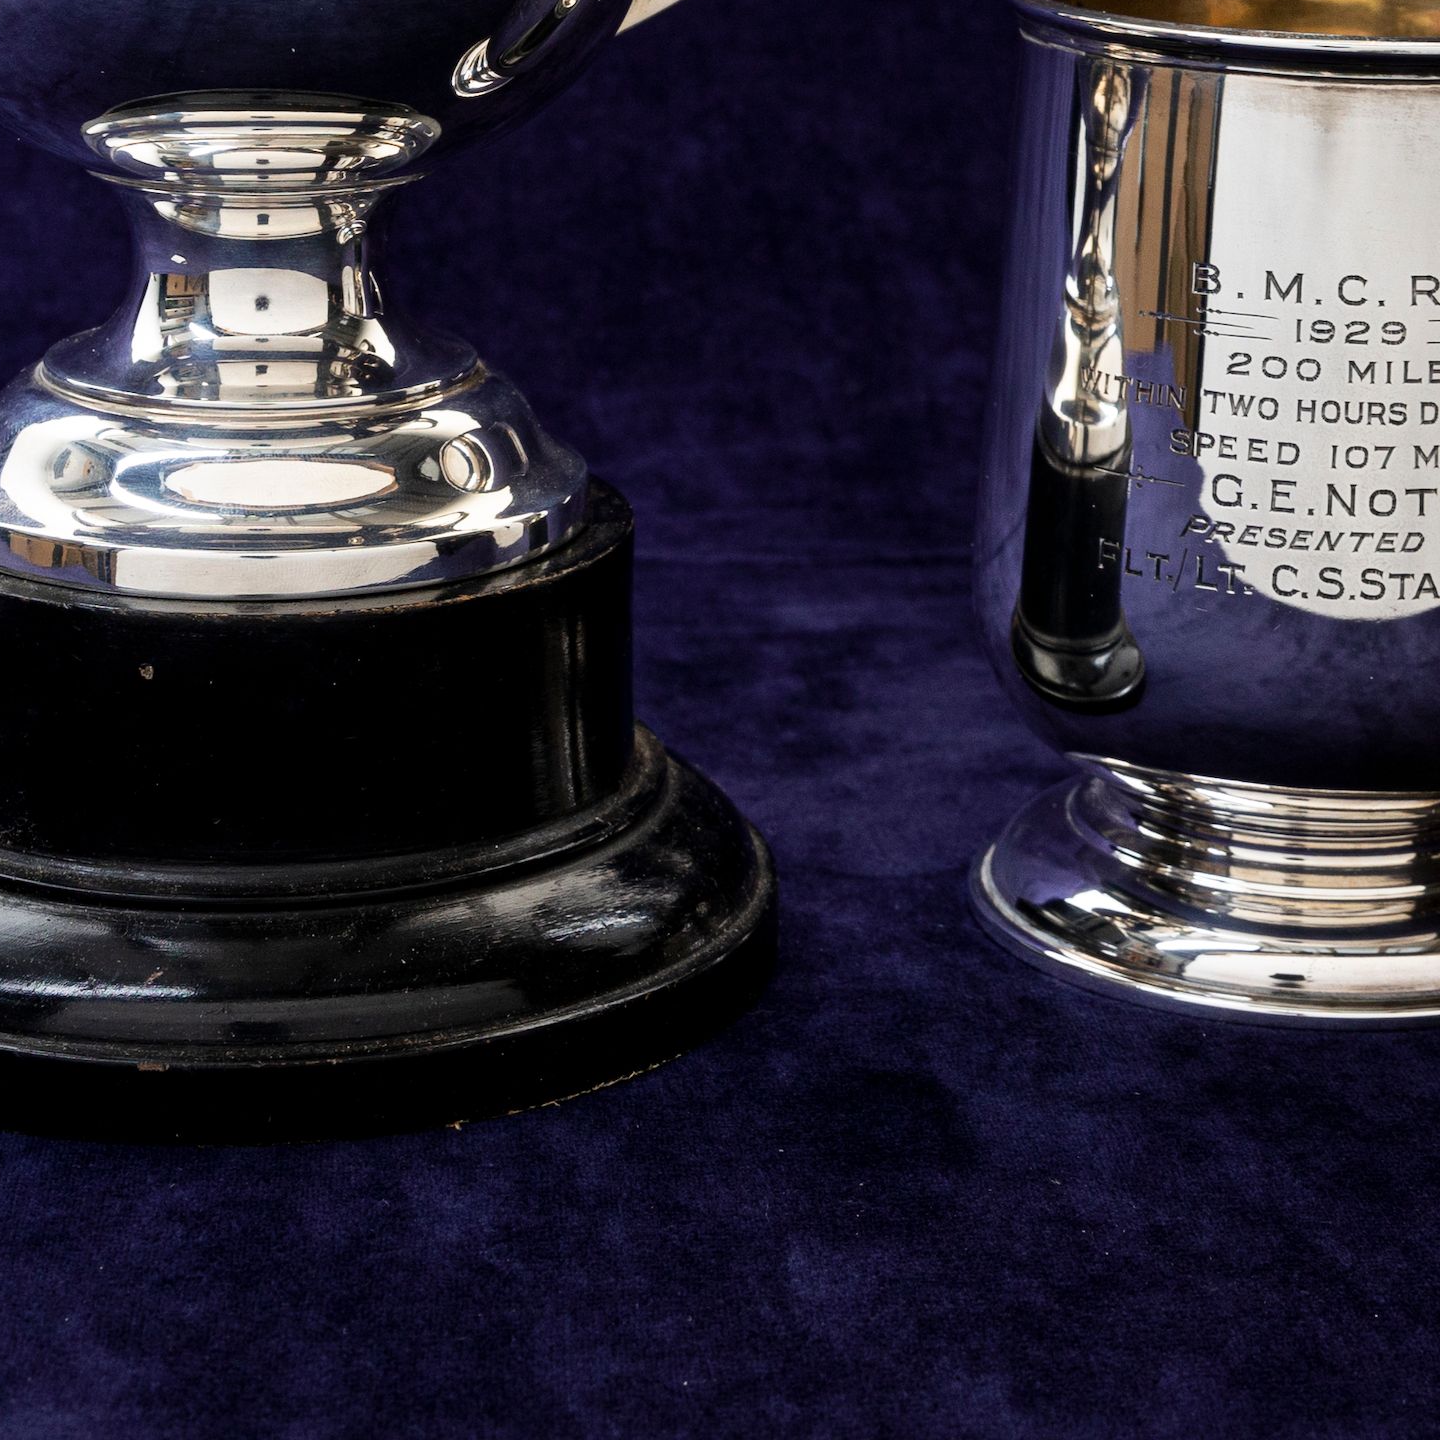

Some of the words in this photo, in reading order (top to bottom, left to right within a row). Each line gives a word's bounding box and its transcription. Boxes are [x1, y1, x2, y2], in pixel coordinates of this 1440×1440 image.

[1295, 319, 1408, 346] 1929
[1227, 352, 1322, 382] 200
[1080, 366, 1187, 410] WITHIN
[1203, 390, 1279, 421] TWO
[1296, 399, 1408, 427] HOURS
[1169, 428, 1301, 466] SPEED
[1331, 446, 1394, 471] 107
[1179, 513, 1425, 555] PRESENTED
